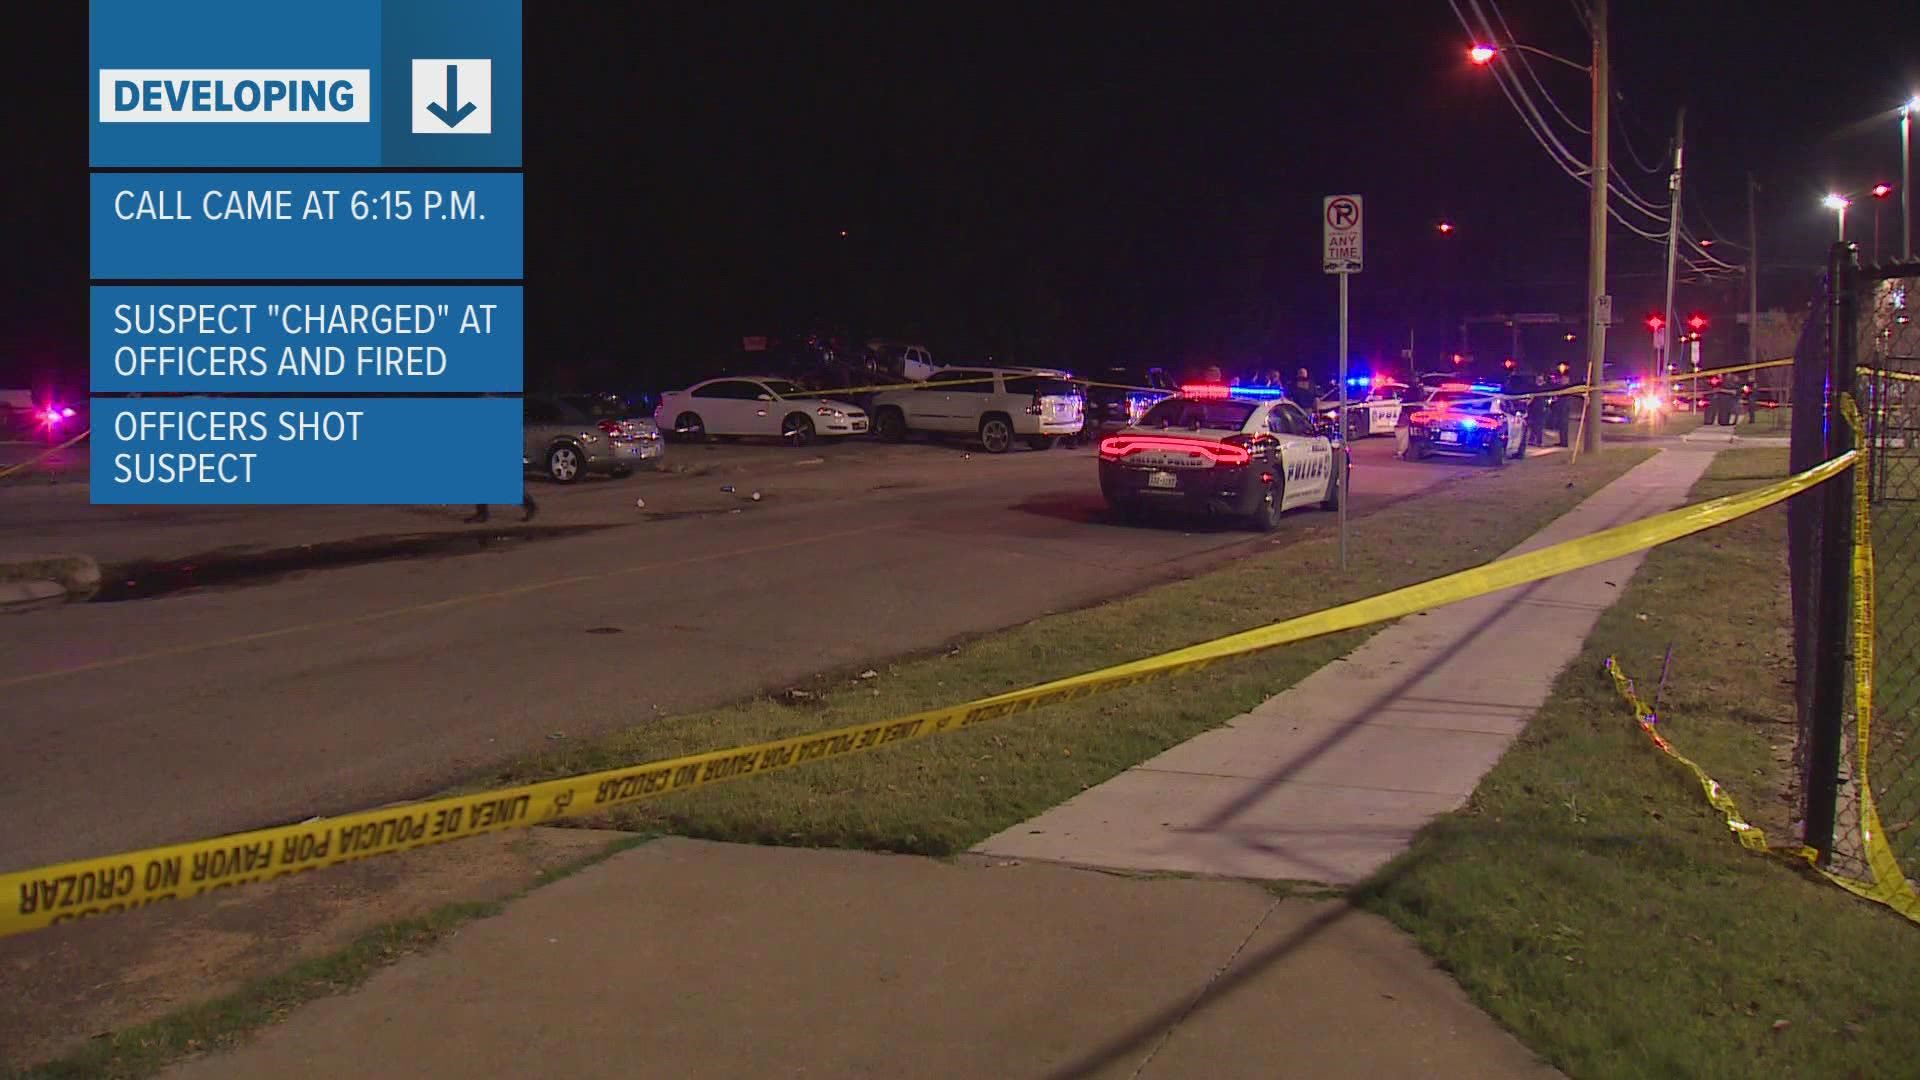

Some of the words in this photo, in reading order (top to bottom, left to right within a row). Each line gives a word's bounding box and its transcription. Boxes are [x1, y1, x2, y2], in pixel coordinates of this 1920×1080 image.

[1329, 236, 1356, 246] ANY
[1329, 247, 1358, 258] TIME
[703, 751, 761, 782] FAVOR
[759, 744, 796, 770] POR
[595, 768, 671, 804] CRUZAR
[673, 763, 702, 788] NO
[432, 809, 461, 836] DE
[470, 794, 531, 822] LINEA
[281, 830, 331, 863] POR
[340, 816, 426, 848] POLICIA
[144, 855, 182, 892] NO
[191, 840, 273, 882] FAVOR
[18, 864, 134, 916] CRUZAR
